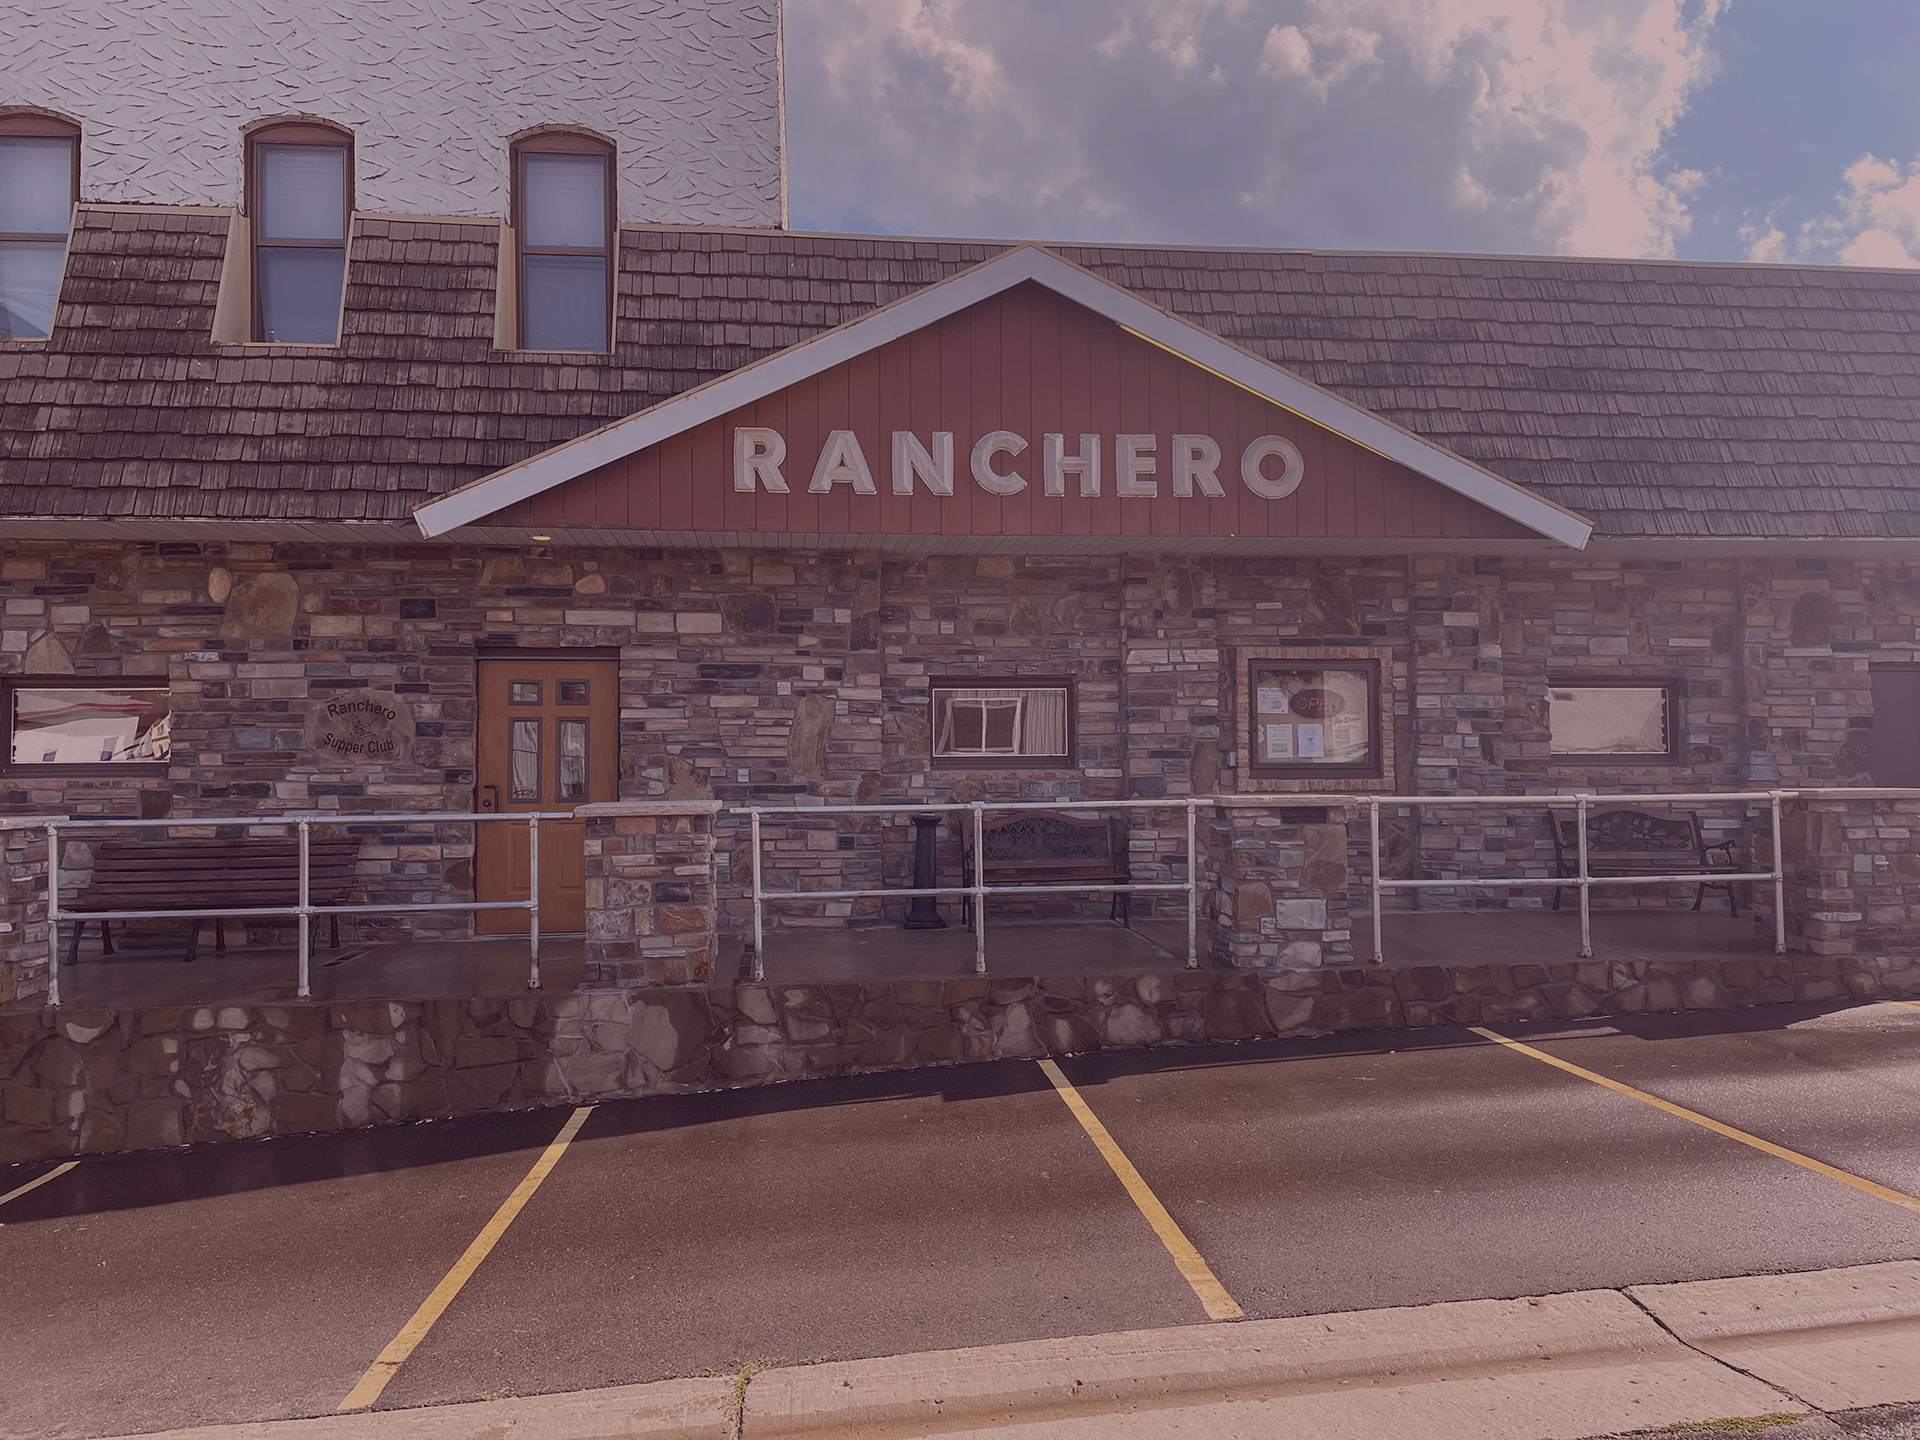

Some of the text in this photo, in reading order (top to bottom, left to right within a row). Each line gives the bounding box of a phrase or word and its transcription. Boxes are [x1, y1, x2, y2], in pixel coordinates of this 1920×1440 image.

[734, 426, 1304, 499] RANCHERO
[327, 700, 396, 720] Ranchero
[1297, 697, 1338, 710] OPEN
[324, 733, 394, 754] Supper Club
